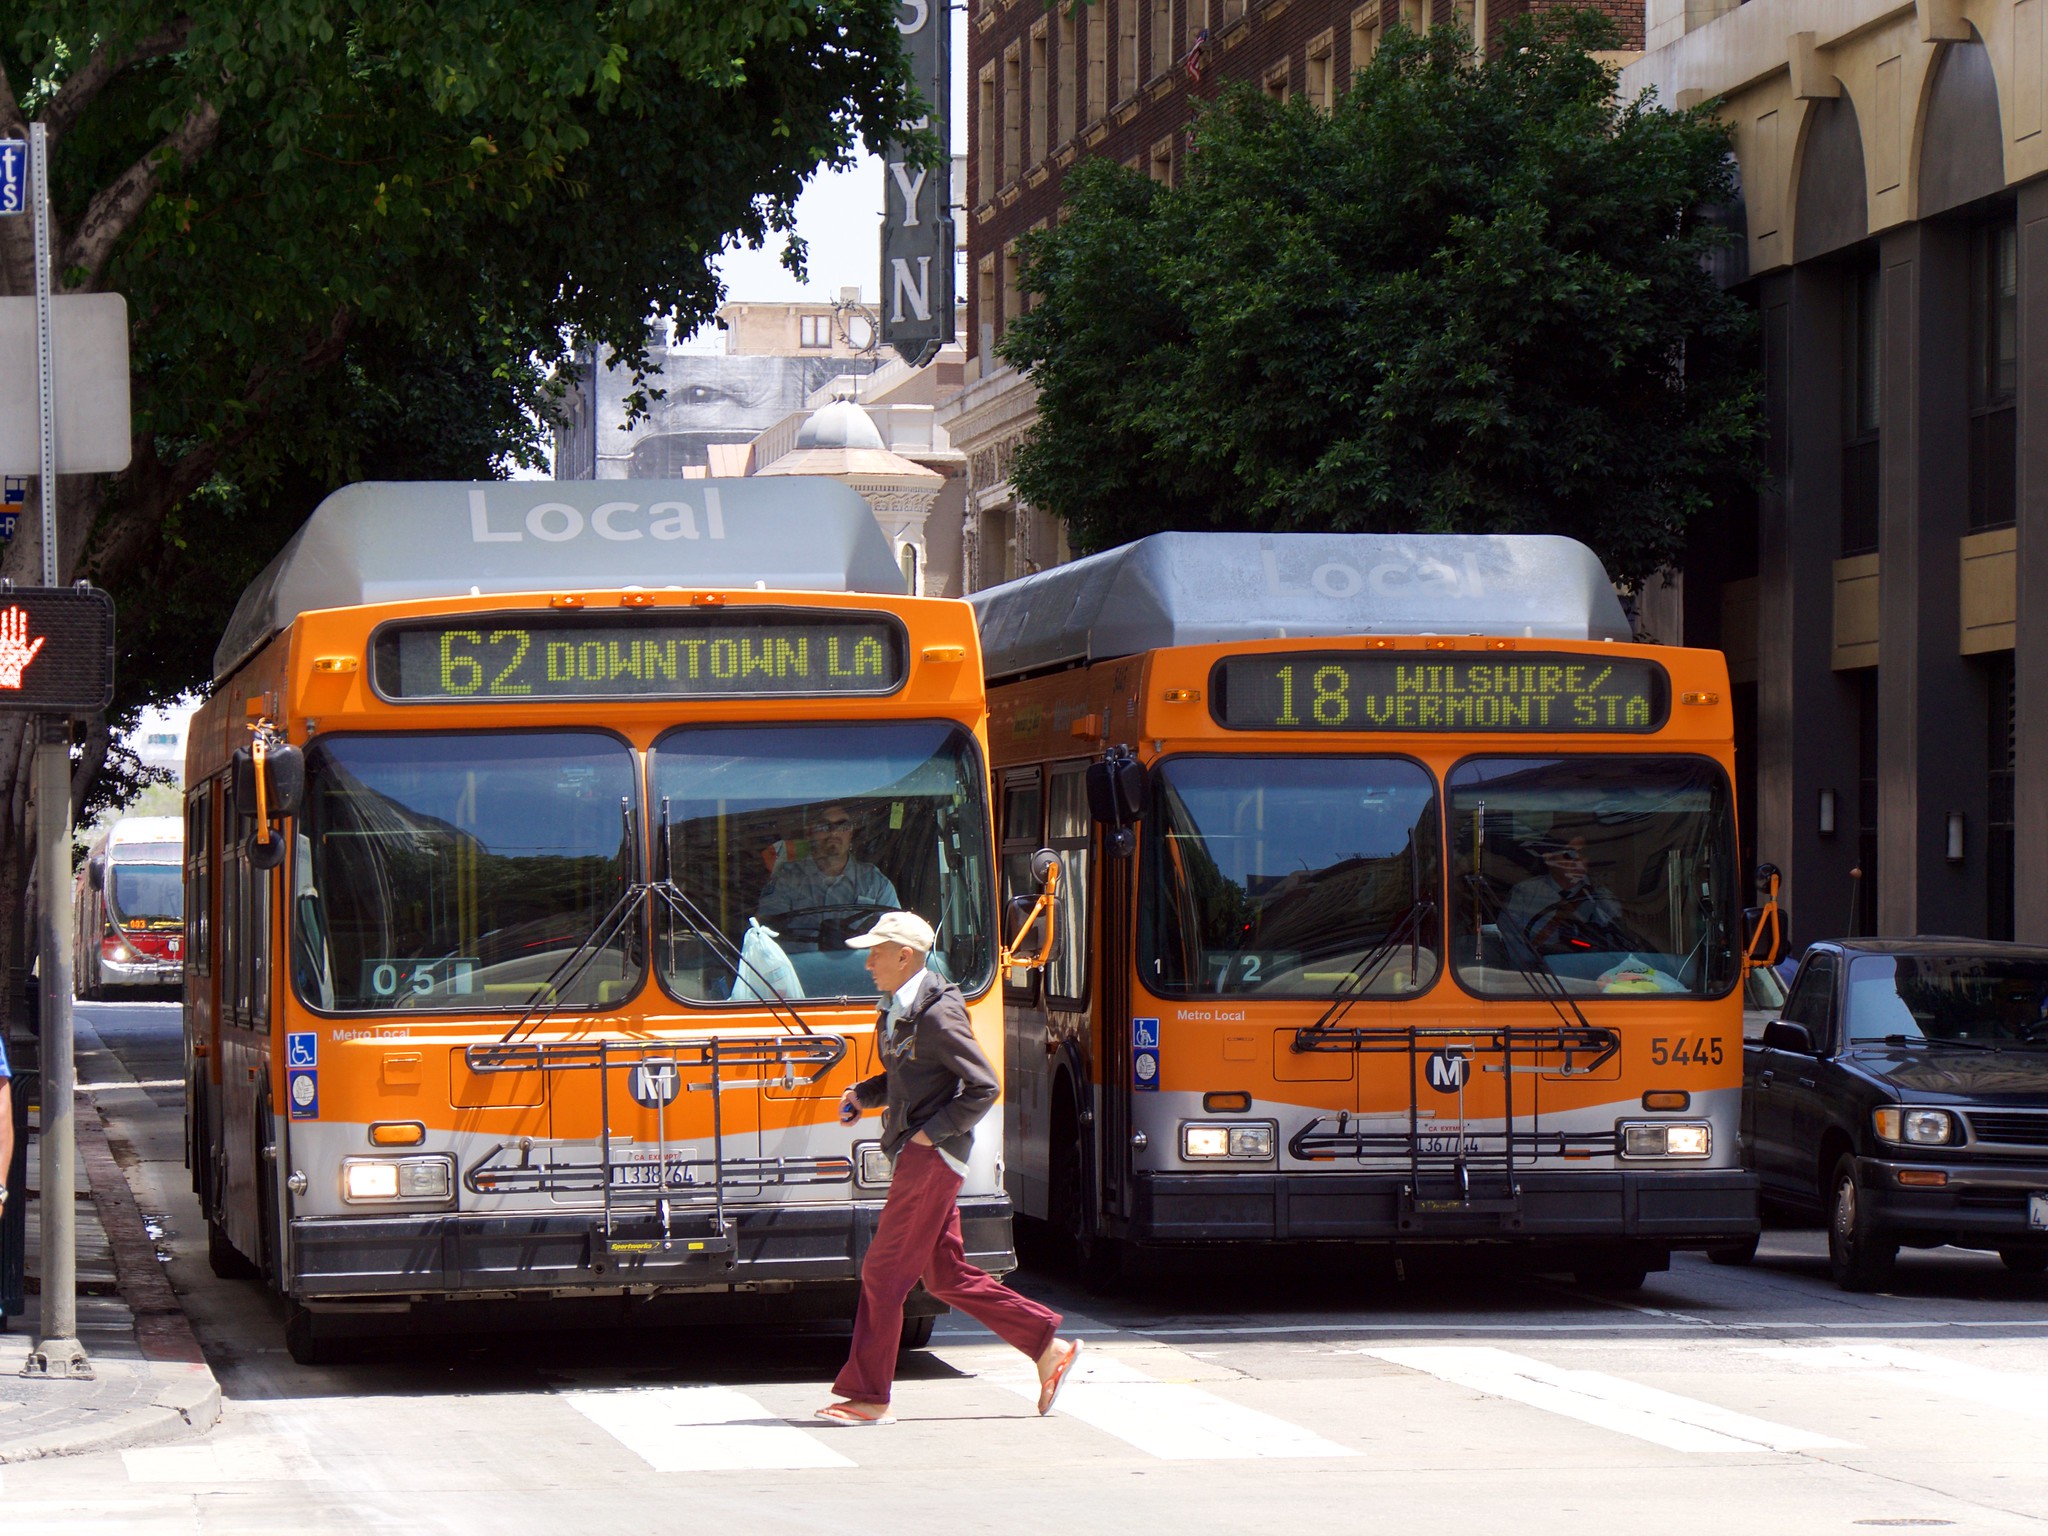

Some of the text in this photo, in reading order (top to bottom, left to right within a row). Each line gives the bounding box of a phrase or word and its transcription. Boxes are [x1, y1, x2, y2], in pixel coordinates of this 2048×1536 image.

[0, 147, 16, 183] t
[468, 486, 726, 542] Local
[1260, 548, 1484, 599] Local
[440, 629, 882, 695] 62 DOWNTOWN LA
[1276, 665, 1349, 726] 18
[1396, 665, 1613, 693] WILSHIRE/
[1366, 695, 1650, 726] VERMONT STA
[1177, 1010, 1246, 1021] Metro Local
[332, 1027, 411, 1041] Metro Local
[1651, 1037, 1724, 1066] 5445
